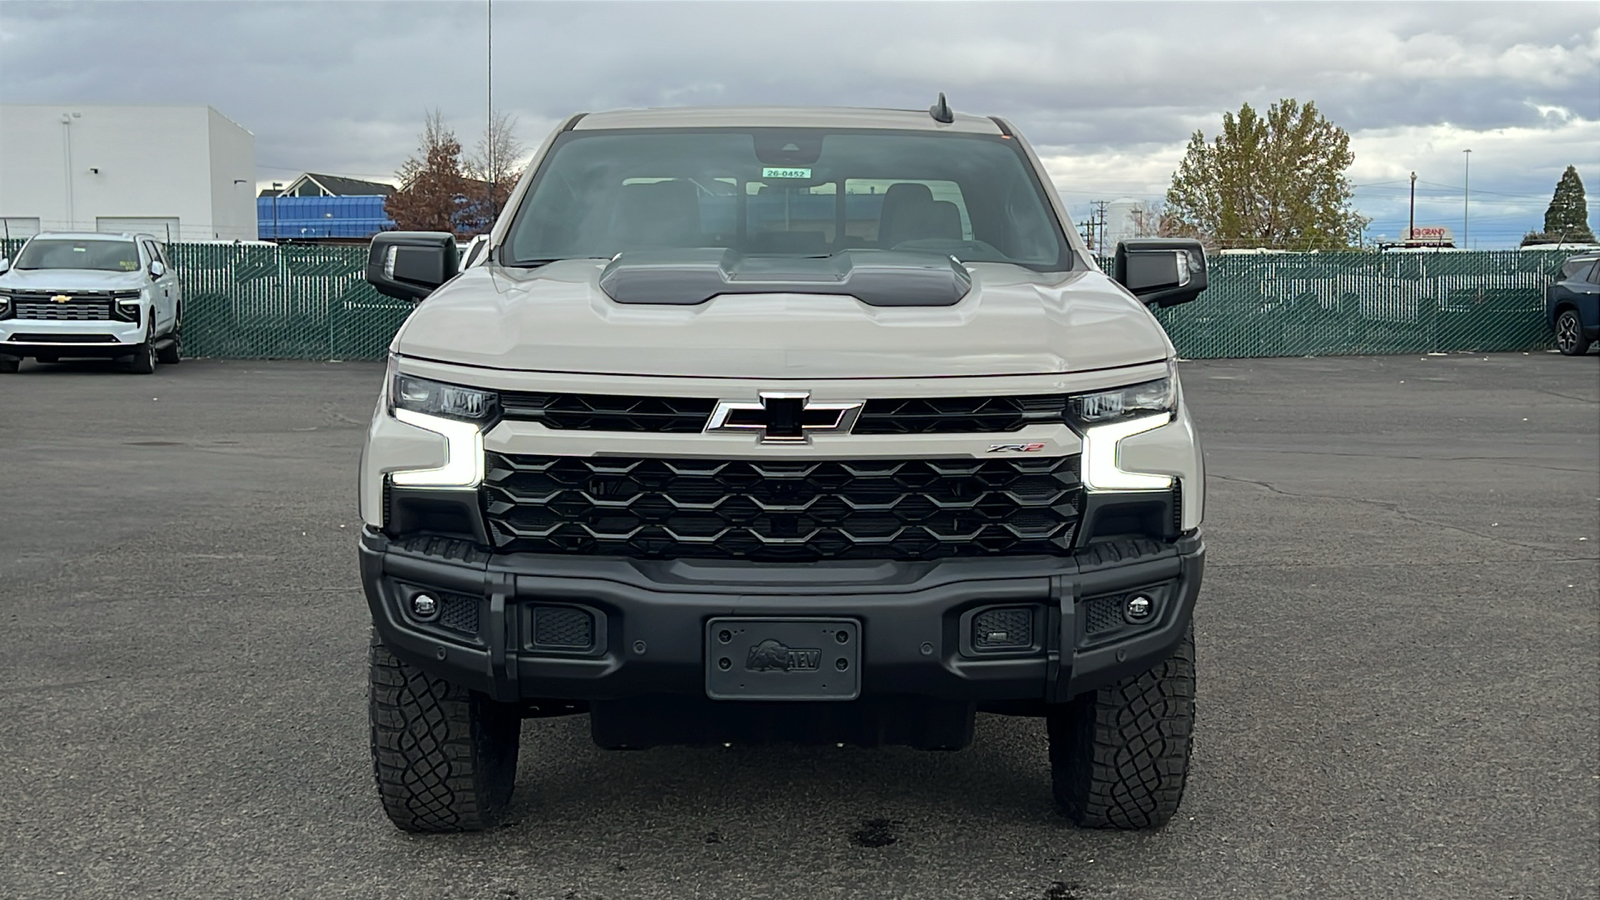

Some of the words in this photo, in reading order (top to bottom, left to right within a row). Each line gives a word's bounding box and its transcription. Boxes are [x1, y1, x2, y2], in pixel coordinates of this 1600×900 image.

[1421, 228, 1445, 236] GRAND
[986, 442, 1046, 453] ZR2
[786, 651, 819, 669] AEV
